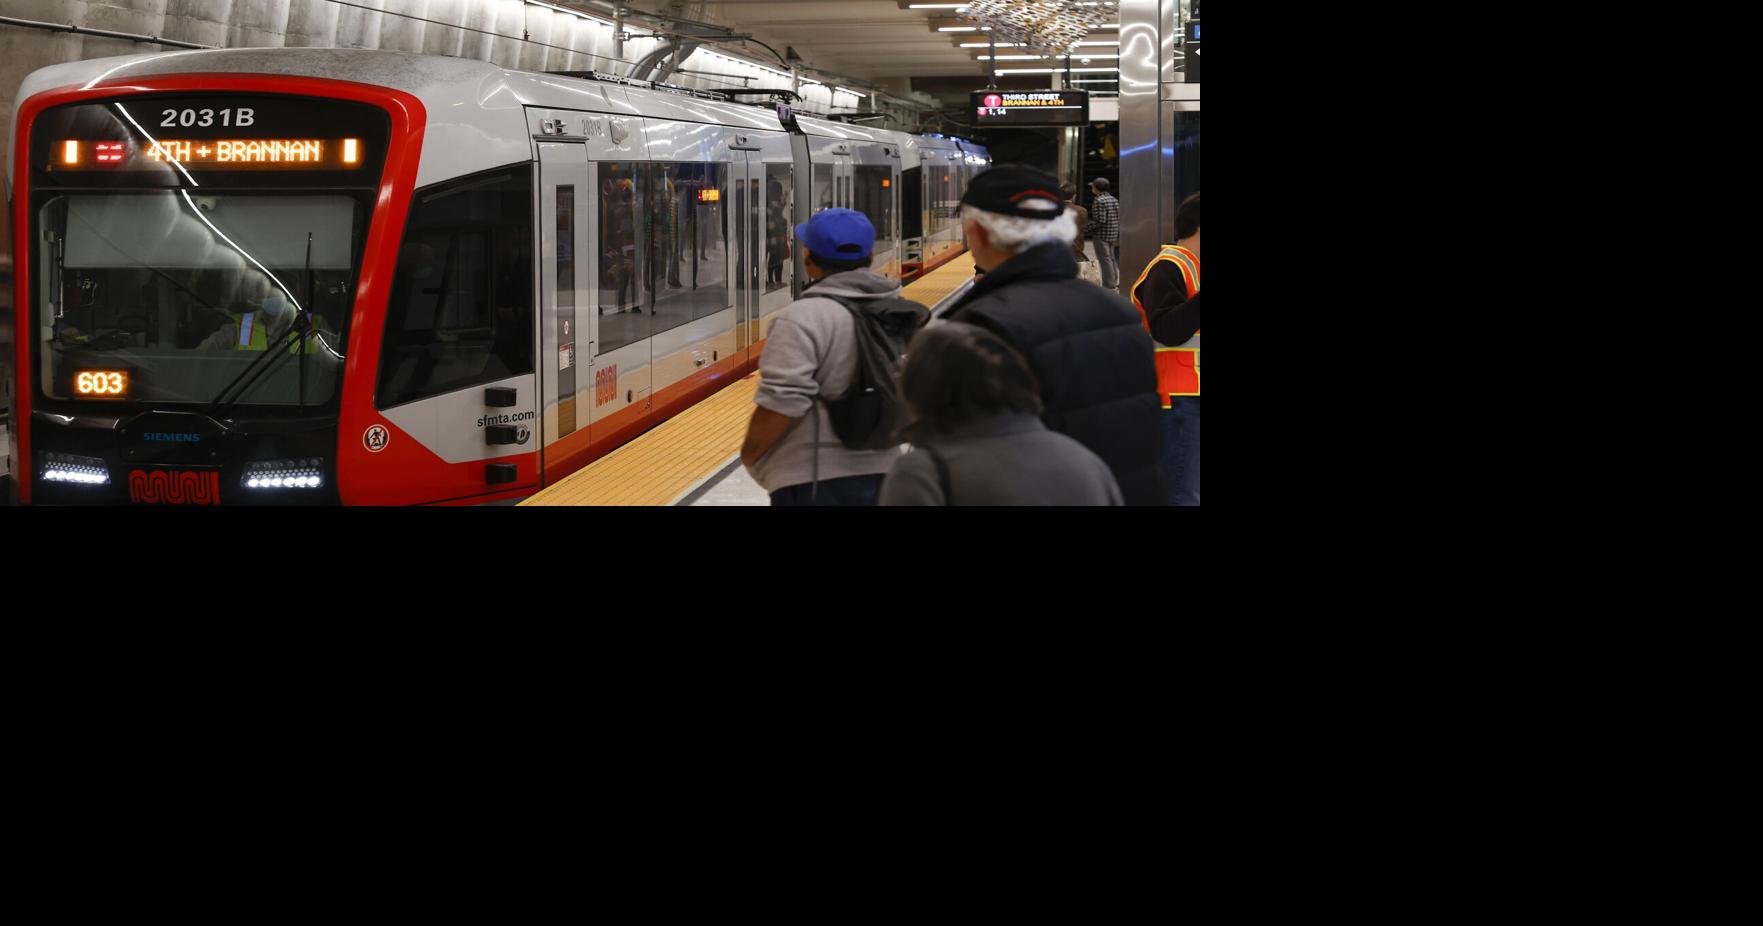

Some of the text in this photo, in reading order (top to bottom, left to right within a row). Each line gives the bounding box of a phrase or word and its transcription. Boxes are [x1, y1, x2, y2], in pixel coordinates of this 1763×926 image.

[988, 96, 997, 106] T
[160, 107, 255, 128] 2031B
[147, 140, 190, 162] 4TH
[196, 147, 211, 158] +
[217, 140, 320, 162] BRANNAN
[77, 372, 123, 394] 603
[477, 411, 535, 427] sfmta.com
[143, 432, 201, 442] SIEMENS
